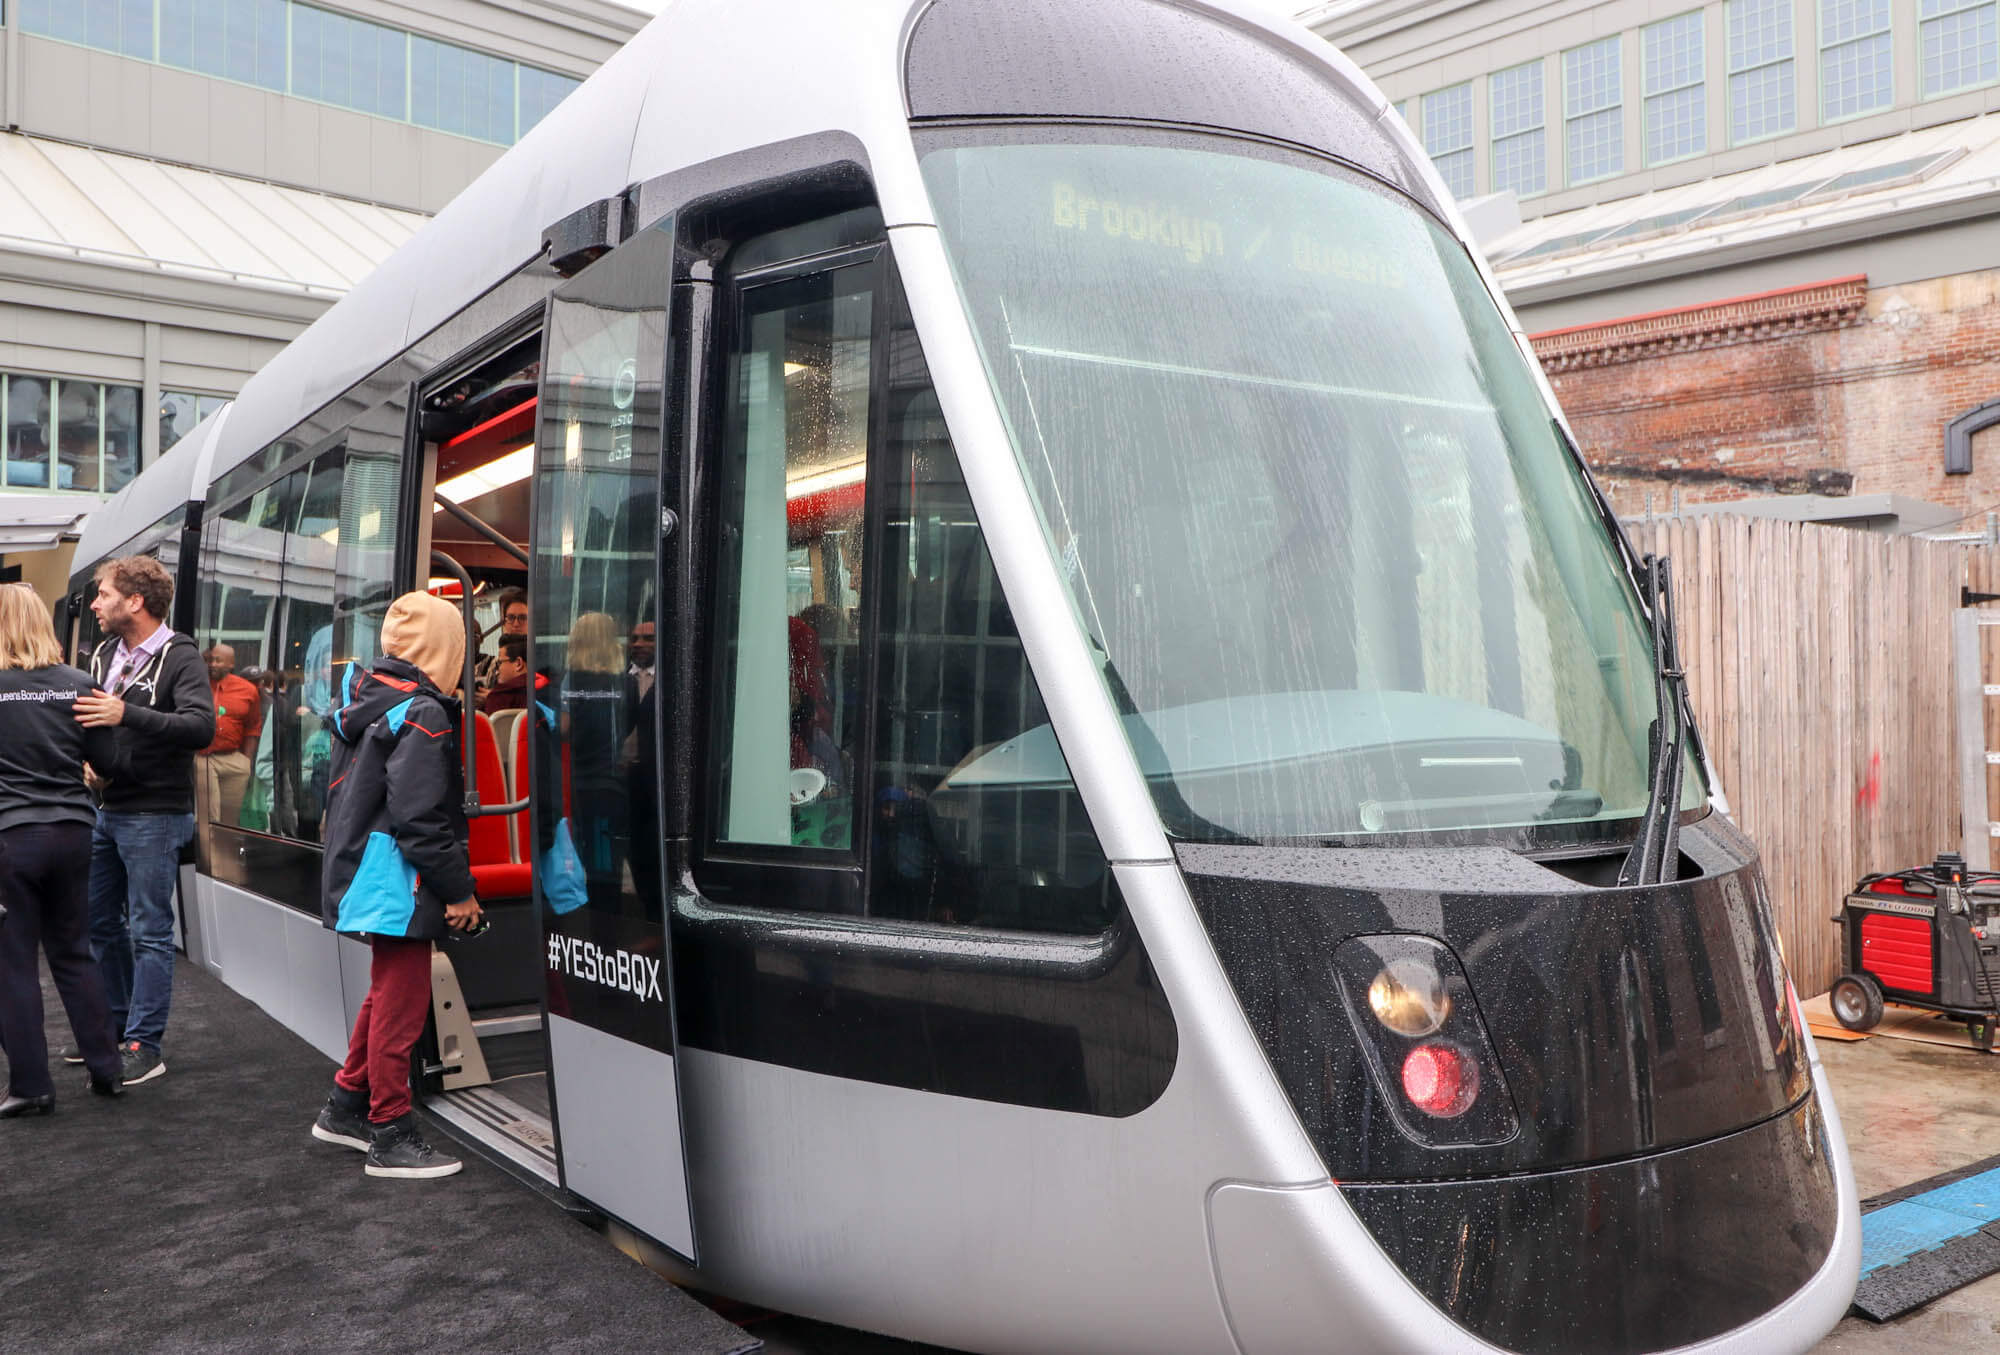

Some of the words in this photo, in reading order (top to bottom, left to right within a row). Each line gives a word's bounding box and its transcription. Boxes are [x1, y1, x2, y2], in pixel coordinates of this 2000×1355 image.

[1052, 181, 1224, 264] Brooklyn
[21, 689, 49, 703] Borough
[49, 688, 77, 700] President
[548, 932, 663, 1002] #YEStoBQX
